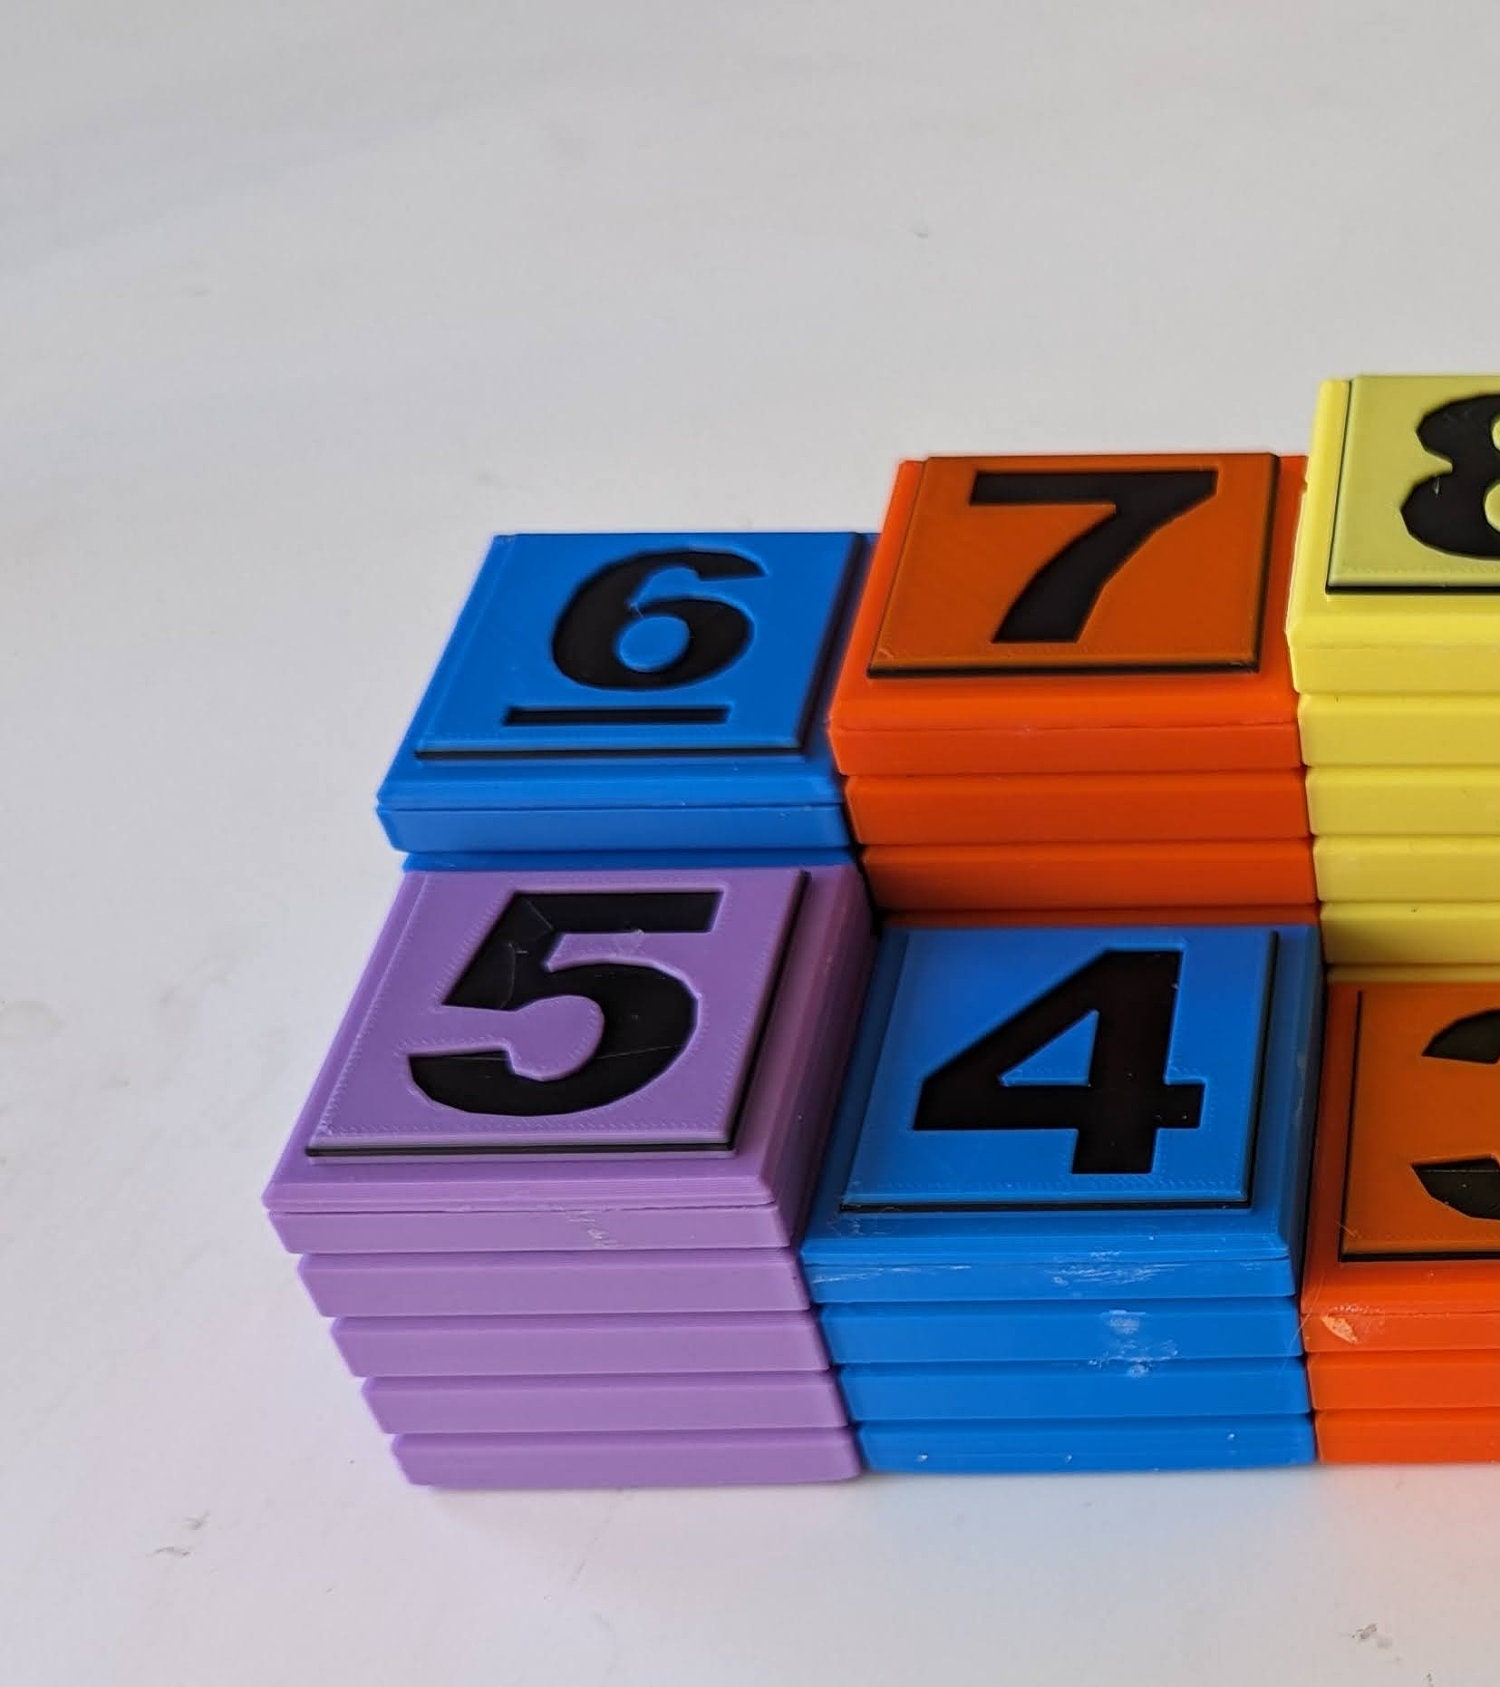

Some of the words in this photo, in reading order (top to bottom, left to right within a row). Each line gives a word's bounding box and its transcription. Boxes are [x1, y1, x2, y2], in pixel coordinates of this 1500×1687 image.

[551, 549, 764, 690] 6
[968, 468, 1218, 645] 7
[408, 890, 722, 1117] 5
[911, 948, 1207, 1176] 4
